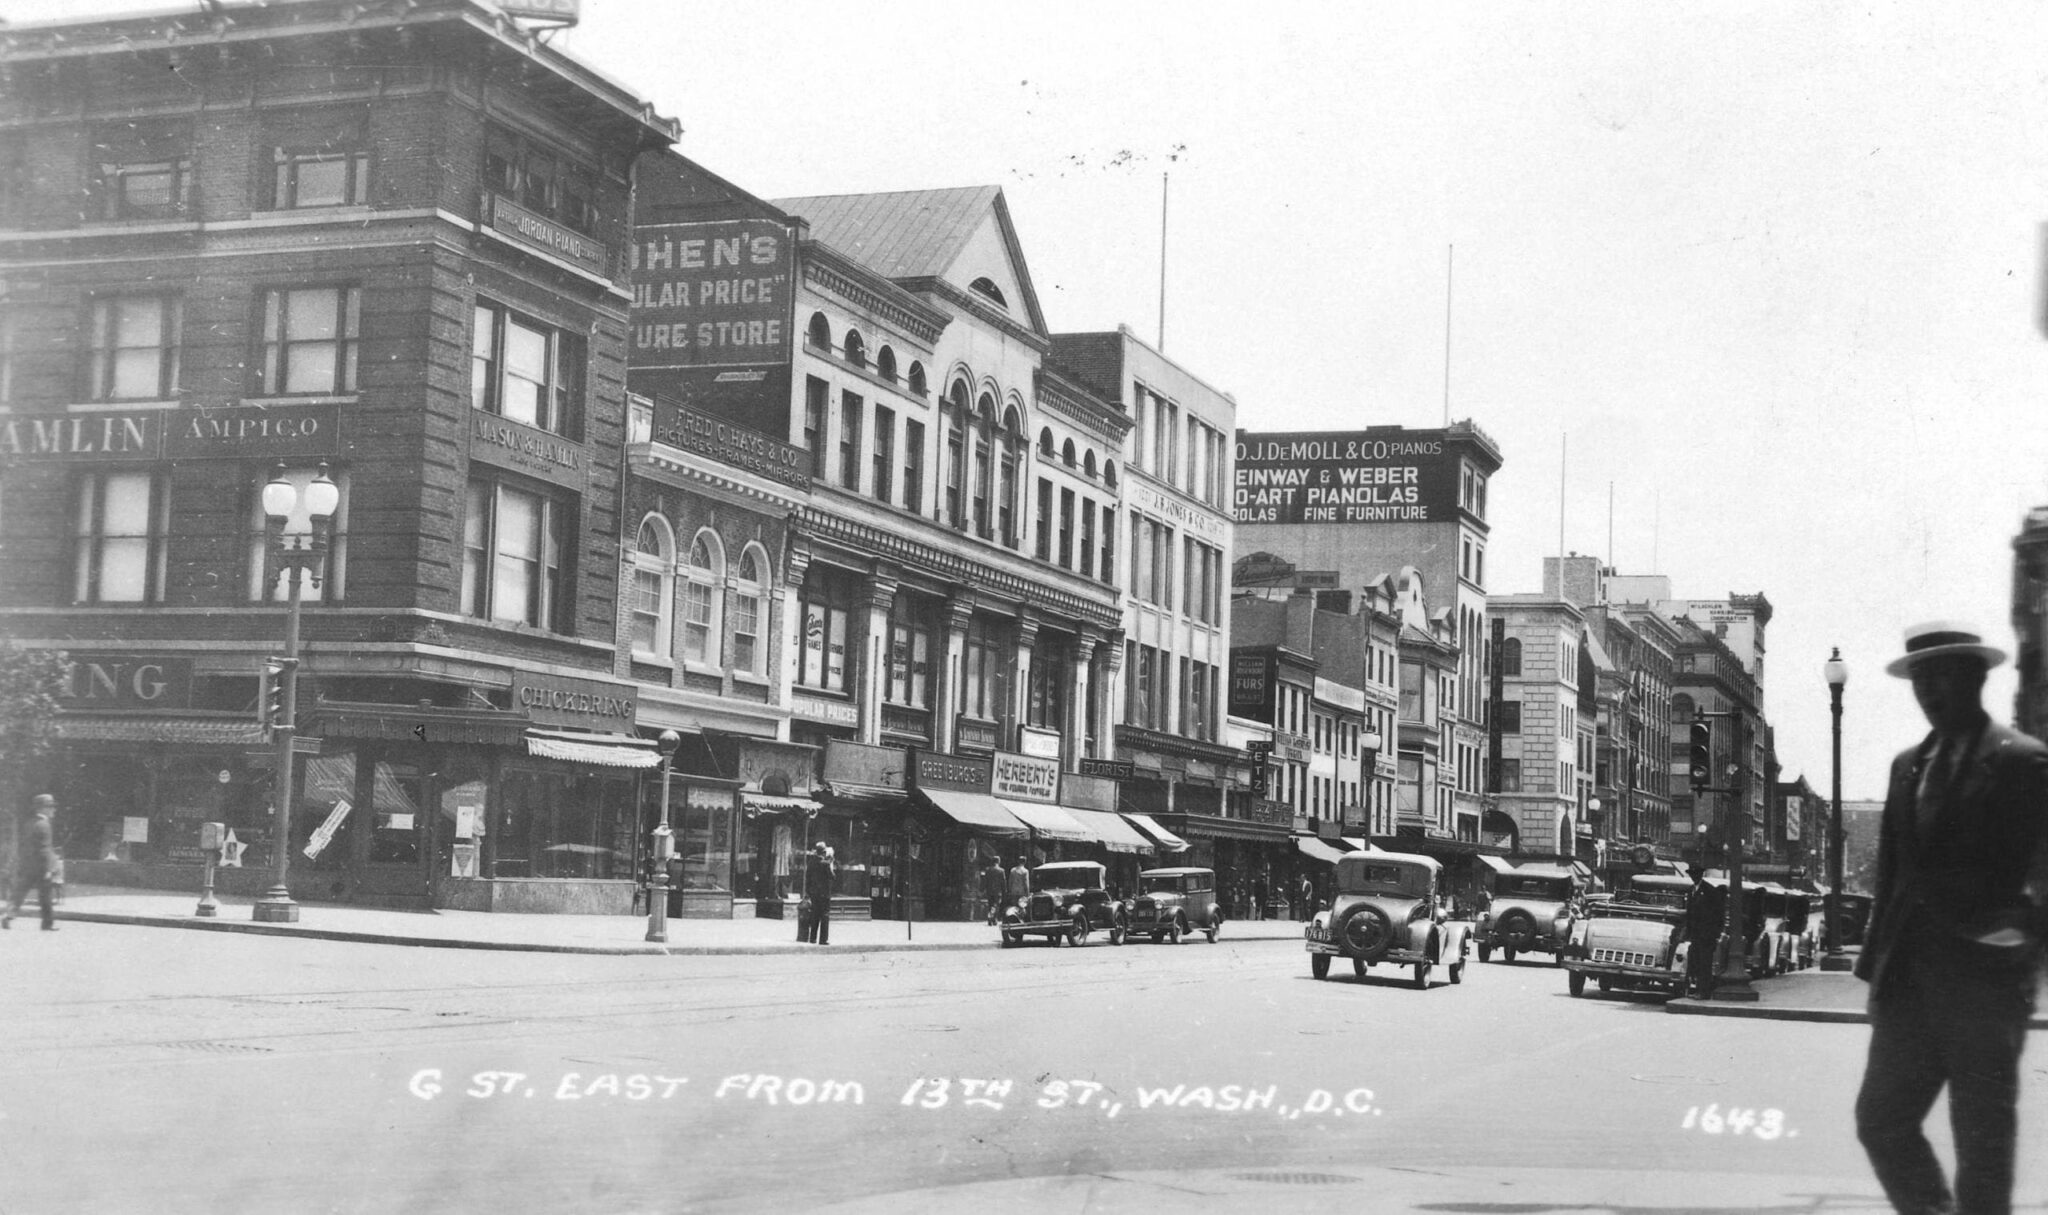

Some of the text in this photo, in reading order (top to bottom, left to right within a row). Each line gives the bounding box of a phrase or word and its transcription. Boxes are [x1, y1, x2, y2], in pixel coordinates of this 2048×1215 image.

[519, 216, 553, 246] JORDAN
[556, 231, 580, 258] PIANO
[698, 320, 781, 346] STORE
[184, 417, 319, 438] AMPICO
[676, 409, 713, 437] FRED
[730, 428, 765, 456] HAYS
[768, 443, 776, 460] &
[476, 420, 522, 452] MASON
[525, 436, 534, 456] &
[535, 439, 579, 471] HAMLIN
[1345, 441, 1359, 460] &
[1391, 441, 1442, 456] PIANOS
[1320, 470, 1330, 484] &
[1339, 467, 1418, 485] WEBER
[1307, 487, 1419, 504] PIANOLAS
[1166, 500, 1187, 522] JONES
[1304, 507, 1337, 520] FINE
[1346, 506, 1428, 520] FURNITURE
[1236, 678, 1264, 690] FURS
[521, 686, 632, 718] CHICKERING
[827, 703, 858, 723] PRICES
[921, 760, 976, 785] GREENBURG'S
[996, 757, 1055, 787] HERBERT'S
[1083, 761, 1132, 778] FLORIST
